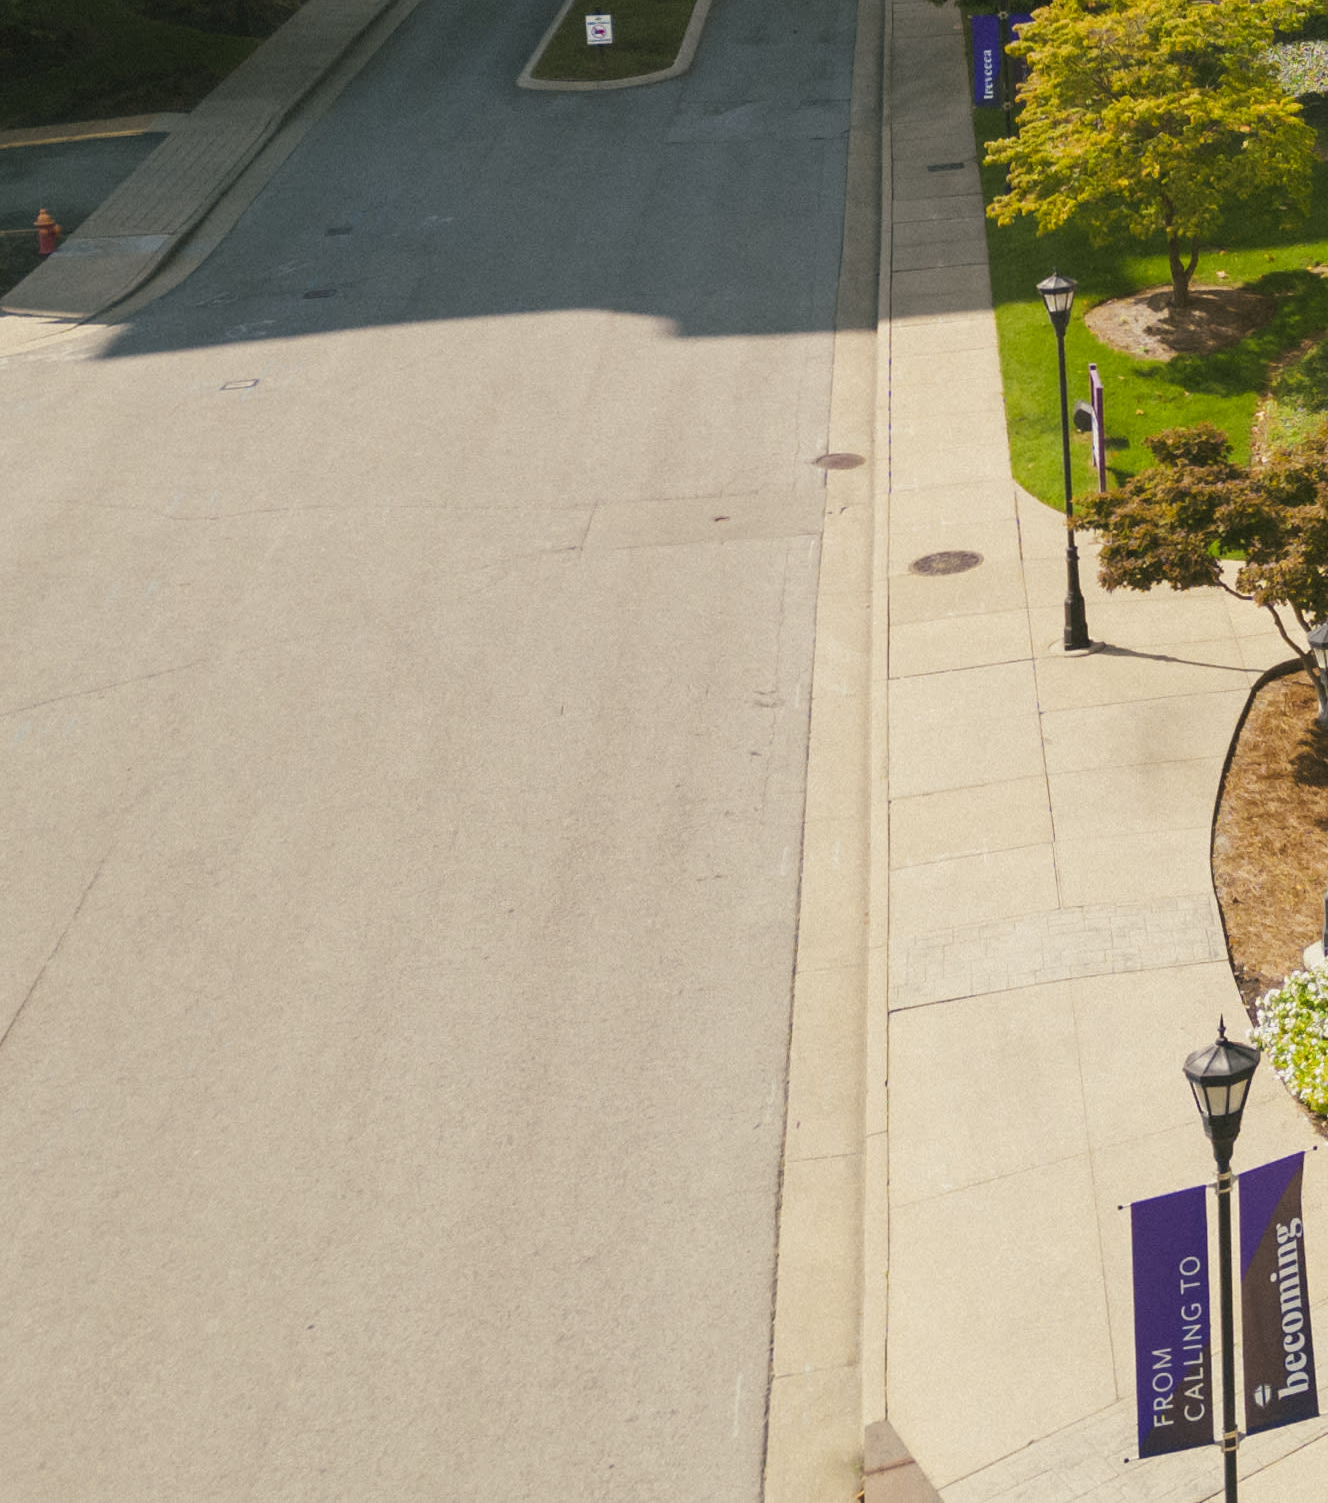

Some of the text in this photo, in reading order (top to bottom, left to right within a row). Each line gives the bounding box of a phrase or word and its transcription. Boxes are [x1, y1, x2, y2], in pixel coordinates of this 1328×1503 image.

[1151, 1347, 1174, 1428] FROM
[1179, 1256, 1206, 1422] CALLING TO
[1269, 1217, 1310, 1401] becoming
